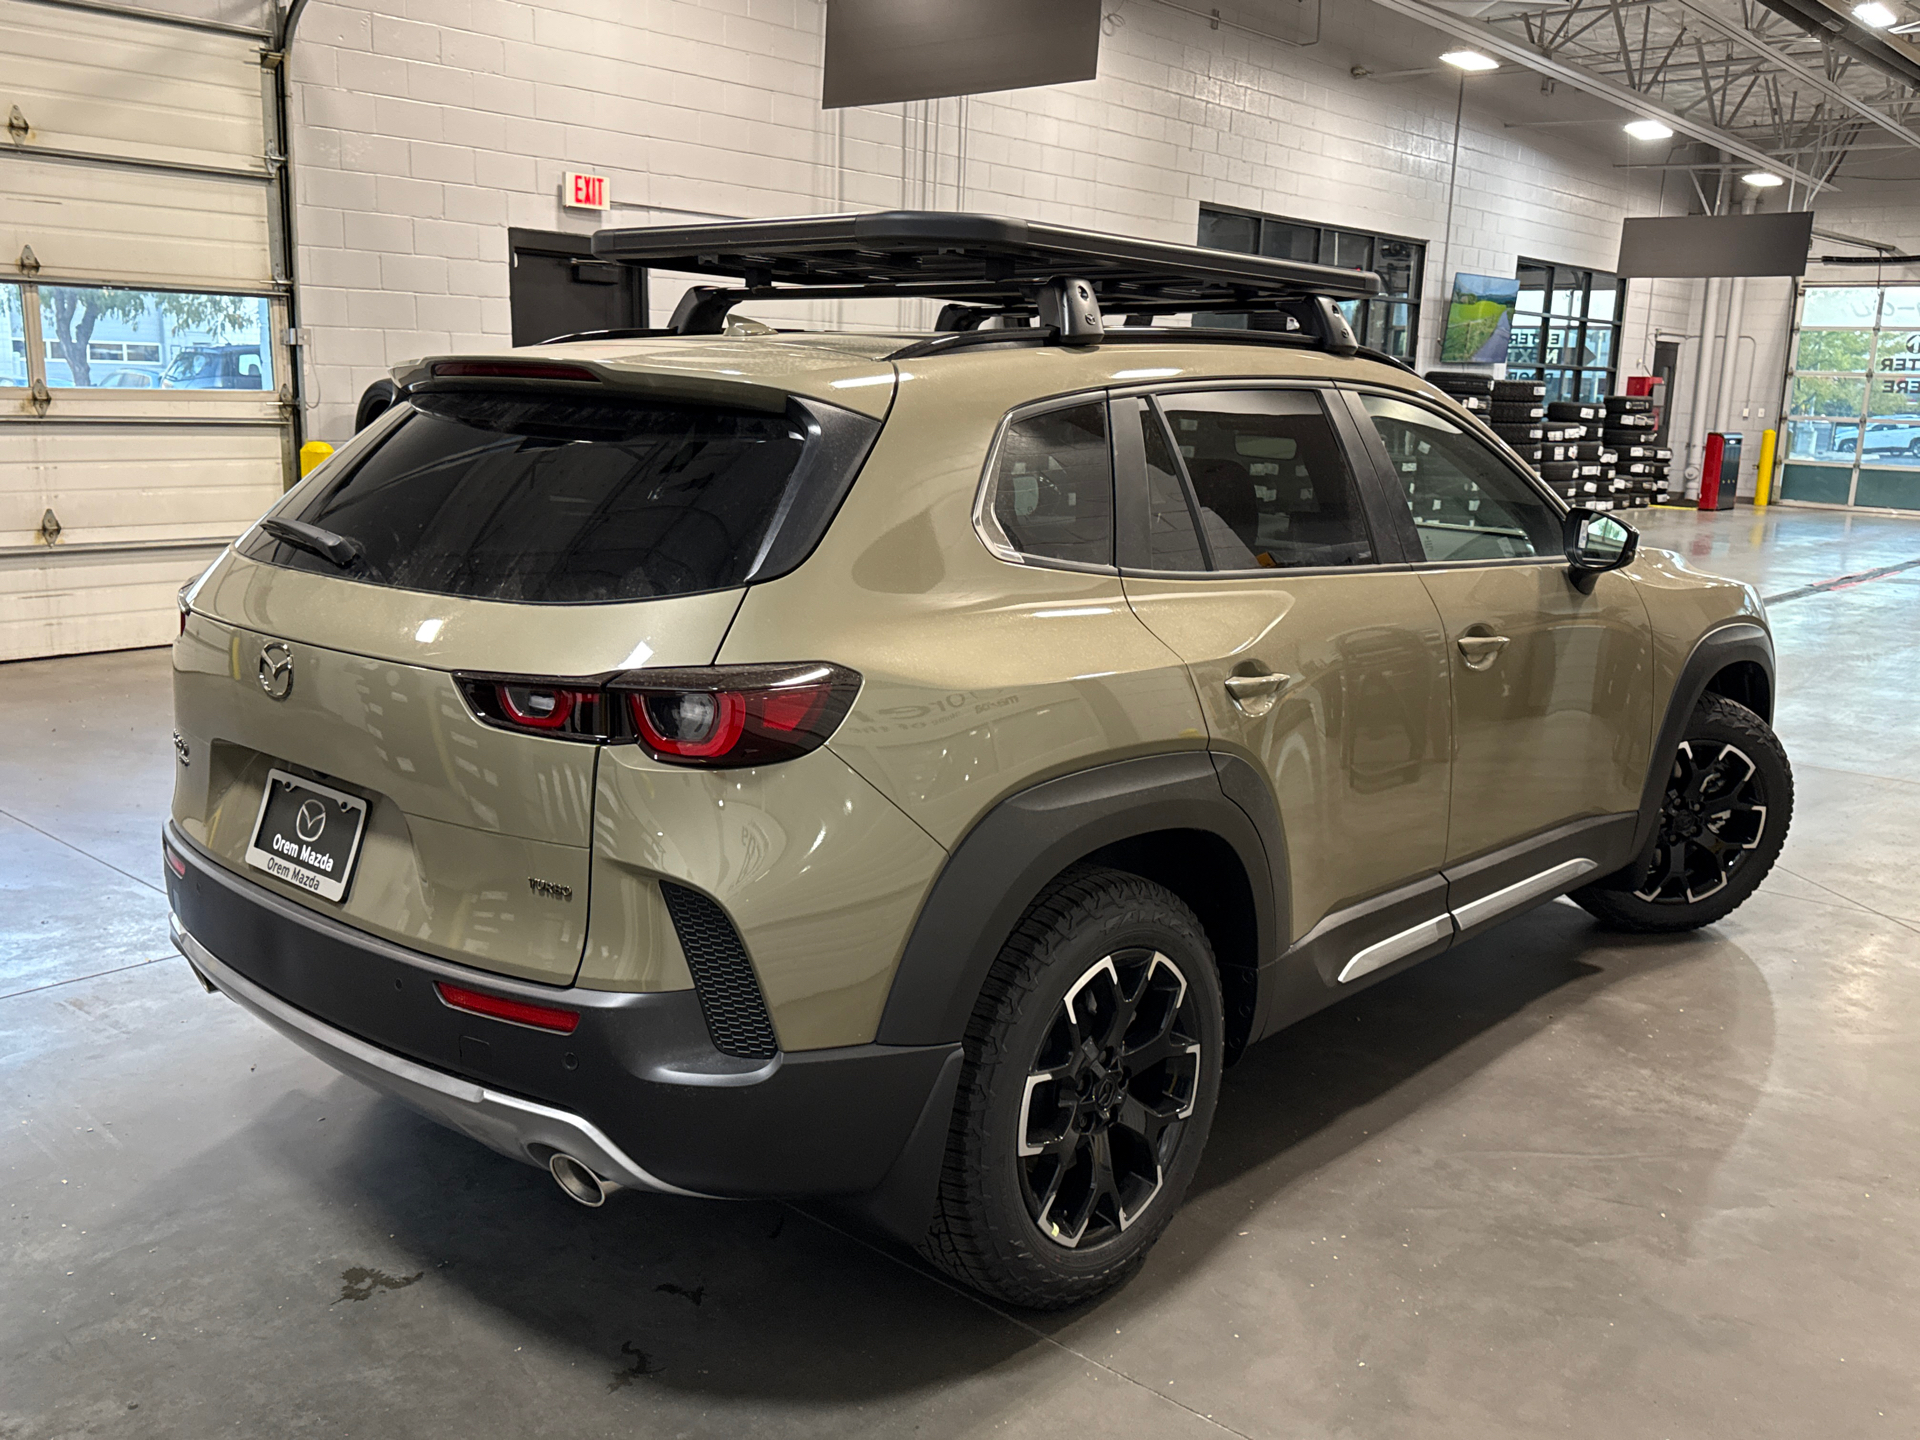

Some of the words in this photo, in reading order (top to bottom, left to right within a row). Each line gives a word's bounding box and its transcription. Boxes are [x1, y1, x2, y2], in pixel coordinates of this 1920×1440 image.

[574, 174, 604, 206] EXIT
[272, 833, 299, 858] Orem
[299, 844, 334, 873] Mazda
[267, 857, 290, 878] Orem
[290, 867, 320, 891] Mazda
